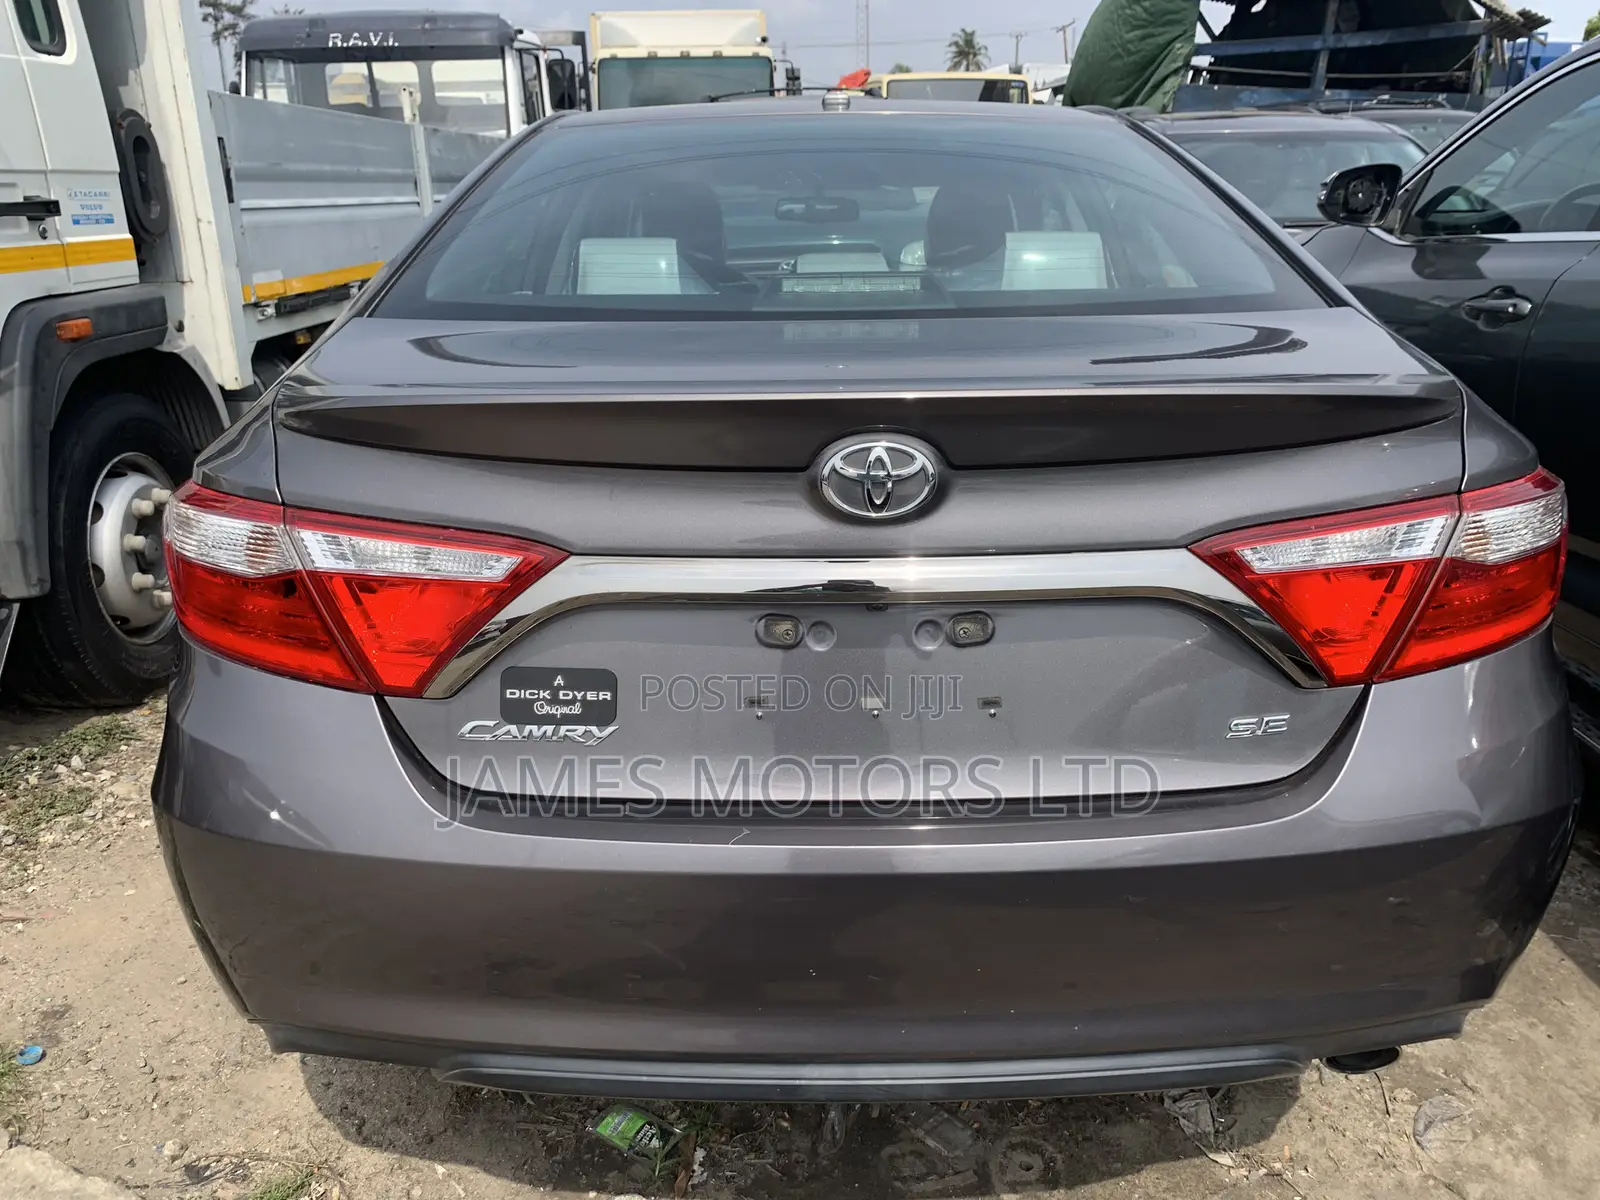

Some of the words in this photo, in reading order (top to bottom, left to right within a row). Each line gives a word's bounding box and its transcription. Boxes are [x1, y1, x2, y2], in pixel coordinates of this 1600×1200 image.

[553, 674, 565, 687] A
[505, 688, 551, 700] DICK
[559, 690, 612, 701] DYER
[533, 700, 582, 718] Original
[457, 720, 620, 746] CAMRY
[1225, 713, 1291, 739] SE
